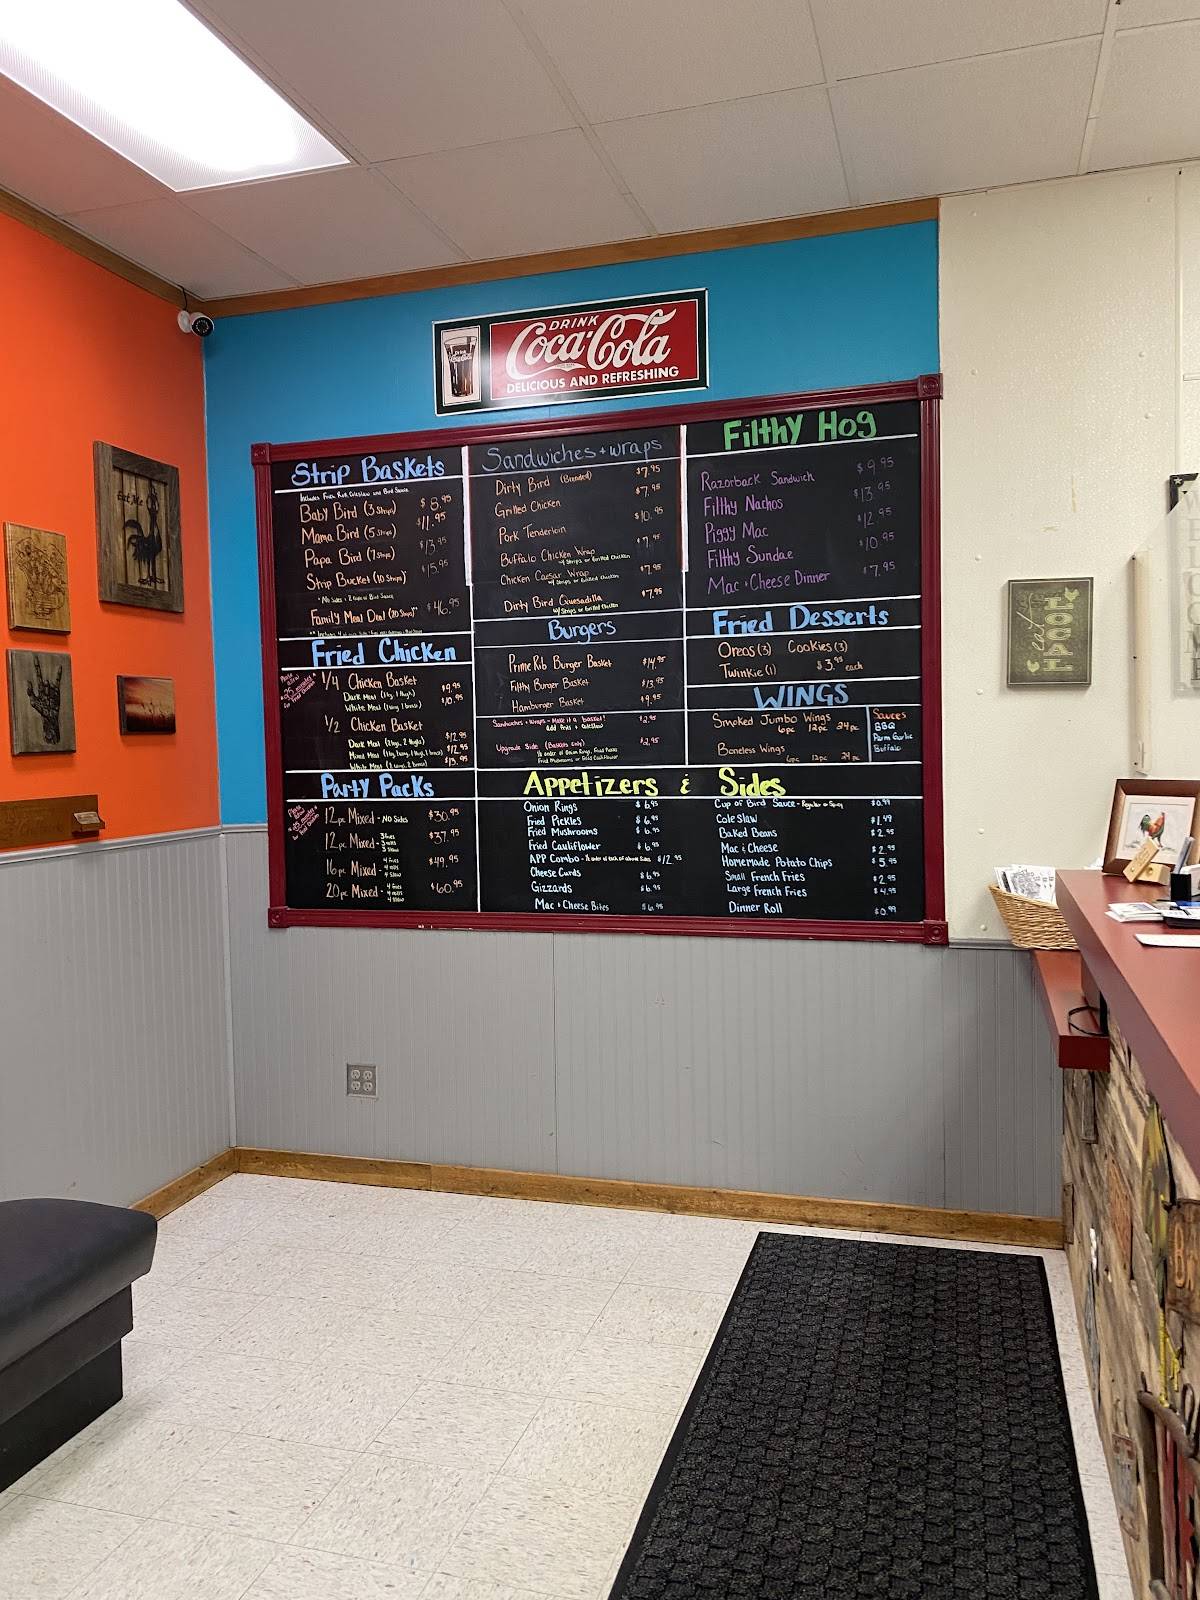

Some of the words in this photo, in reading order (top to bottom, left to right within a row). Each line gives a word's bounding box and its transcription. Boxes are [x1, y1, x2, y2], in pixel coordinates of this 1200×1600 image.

[549, 315, 599, 332] DRINK
[505, 308, 677, 380] Coca-Cola
[506, 378, 566, 394] DELICIOUS
[569, 375, 598, 387] AND
[602, 366, 679, 384] REFRESHING
[818, 410, 877, 441] Hog
[481, 443, 596, 472] Sandwiches
[291, 462, 350, 486] Strip
[361, 455, 445, 482] Baskets
[496, 480, 521, 496] Dirty
[528, 477, 550, 492] Bird
[701, 471, 761, 491] Razorback
[771, 470, 815, 486] Sandwich
[300, 504, 329, 523] Baby
[333, 501, 357, 520] Bird
[495, 502, 527, 518] Grilled
[530, 498, 561, 513] Chicken
[704, 496, 737, 517] Filthy
[745, 495, 784, 511] Nachos
[301, 527, 334, 545] Mama
[336, 523, 360, 542] Bird
[499, 527, 519, 544] Pork
[524, 524, 566, 539] Tenderloin
[705, 521, 736, 544] Piggy
[742, 521, 768, 538] Mac
[304, 548, 332, 569] Papa
[339, 547, 361, 566] Bird
[500, 553, 537, 567] Buffalo
[541, 549, 571, 562] Chicken
[707, 549, 740, 568] Filthy
[746, 544, 794, 564] Sundae
[306, 575, 332, 591] Strip
[336, 572, 370, 587] Bucket
[500, 574, 531, 585] Chicken
[535, 571, 562, 582] Caesar
[707, 576, 740, 595] Mac
[750, 573, 790, 591] Cheese
[795, 570, 830, 586] Dinner
[504, 599, 528, 613] Dirty
[532, 596, 554, 609] Bird
[559, 594, 602, 606] Quesadilla
[310, 608, 340, 626] Family
[344, 609, 364, 623] Meal
[367, 608, 386, 623] Deal
[713, 609, 773, 635] Fried
[790, 604, 889, 630] Desserts
[547, 619, 617, 642] Burgers
[311, 640, 365, 667] Fried
[378, 638, 456, 663] Chicken
[718, 642, 755, 658] Oreos
[758, 642, 772, 657] (3)
[788, 639, 833, 653] Cookies
[834, 640, 848, 653] (3)
[553, 655, 582, 673] Burger
[587, 654, 614, 668] Basket
[719, 662, 764, 679] Twinkie
[845, 662, 863, 671] each
[322, 671, 340, 691] 1/4
[348, 673, 382, 690] Chicken
[386, 671, 417, 688] Basket
[534, 680, 559, 694] Burger
[563, 677, 590, 689] Basket
[512, 699, 554, 713] Hamburger
[559, 697, 585, 707] Basket
[754, 683, 849, 709] WINGS
[712, 713, 754, 729] Smoked
[760, 713, 797, 725] Jumbo
[803, 712, 832, 727] Wings
[873, 708, 907, 720] Sauces
[325, 714, 340, 734] 1/2
[351, 717, 386, 733] Chicken
[391, 718, 423, 733] Basket
[874, 721, 896, 731] BBQ
[717, 743, 756, 756] Boneless
[760, 743, 785, 754] Wings
[320, 772, 370, 799] Party
[379, 772, 435, 798] Packs
[523, 771, 658, 797] Appetizers
[718, 767, 786, 797] Sides
[524, 801, 549, 812] Onion
[554, 801, 578, 814] Rings
[715, 799, 731, 809] Cup
[746, 799, 766, 807] Bird
[772, 799, 796, 808] Sauce
[348, 807, 375, 825] Mixed
[527, 815, 545, 826] Fried
[552, 815, 582, 825] Pickles
[349, 832, 375, 849] Mixed
[528, 827, 546, 837] Fried
[551, 827, 598, 836] Mushrooms
[719, 827, 748, 838] Baked
[752, 827, 777, 837] Beans
[529, 840, 547, 851] Fried
[552, 840, 601, 851] Cauliflower
[721, 843, 739, 854] Mac
[748, 843, 779, 854] Cheese
[529, 855, 546, 863] APP
[550, 854, 580, 863] Combo
[721, 856, 770, 868] Homemade
[776, 858, 806, 868] Potato
[809, 857, 833, 869] Chips
[351, 860, 376, 877] Mixed
[530, 866, 557, 877] Cheese
[558, 868, 581, 877] Curds
[725, 871, 745, 881] Small
[751, 872, 780, 882] French
[782, 871, 806, 881] Fries
[352, 883, 378, 899] Mixed
[531, 881, 572, 893] Gizzards
[727, 884, 751, 896] Large
[754, 884, 782, 896] French
[784, 886, 807, 897] Fries
[535, 898, 554, 910] Mac
[562, 900, 589, 911] Cheese
[591, 901, 609, 912] Bites
[729, 901, 760, 913] Dinner
[764, 903, 783, 913] Roll
